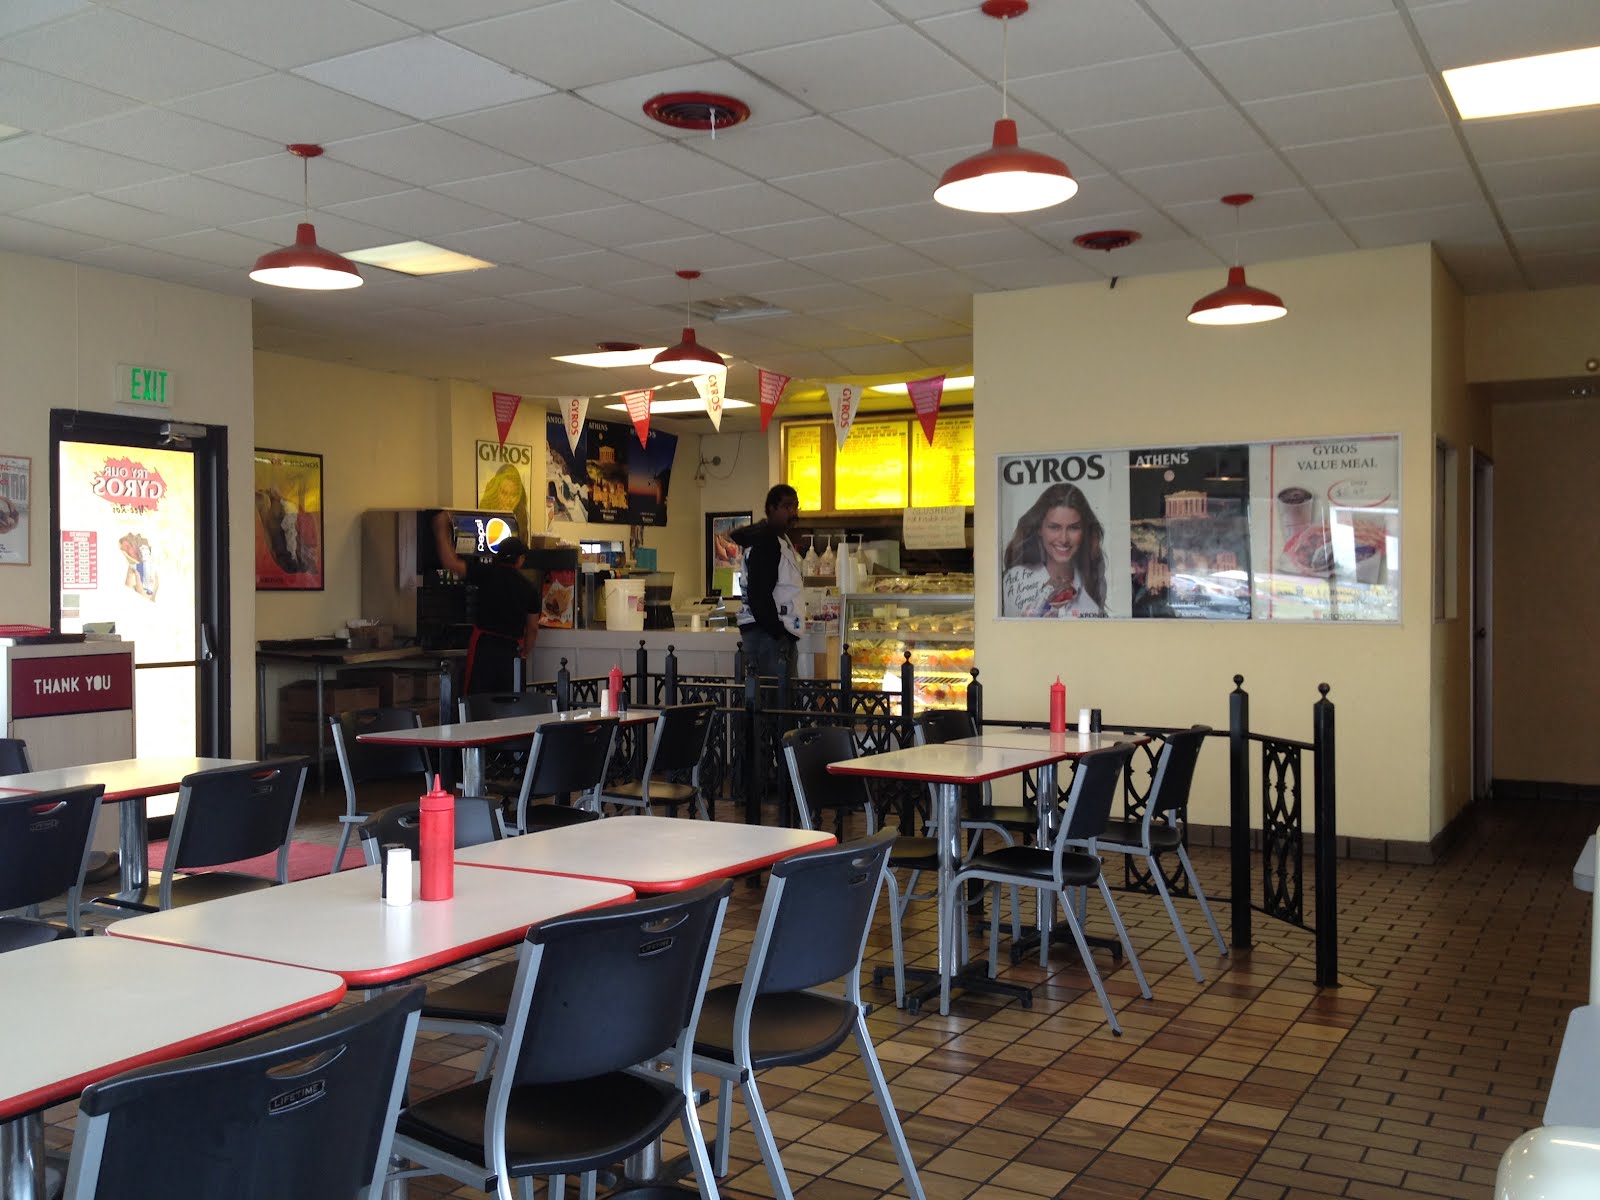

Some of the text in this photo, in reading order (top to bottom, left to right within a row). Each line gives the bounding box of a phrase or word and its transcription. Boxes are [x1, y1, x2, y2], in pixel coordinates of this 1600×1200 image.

[131, 368, 167, 402] EXIT
[708, 375, 721, 411] GYROS
[570, 399, 579, 436] GYROS
[841, 388, 851, 429] GYROS
[588, 421, 608, 431] ATHENS
[478, 443, 531, 465] GYROS
[1135, 452, 1189, 467] ATHENS
[1312, 443, 1357, 455] GYROS
[1003, 454, 1105, 486] GYROS
[1297, 457, 1378, 471] VALUE MEAL
[475, 519, 486, 552] pepsi
[34, 675, 111, 695] THANK YOU
[274, 1084, 319, 1107] LIFETIME
